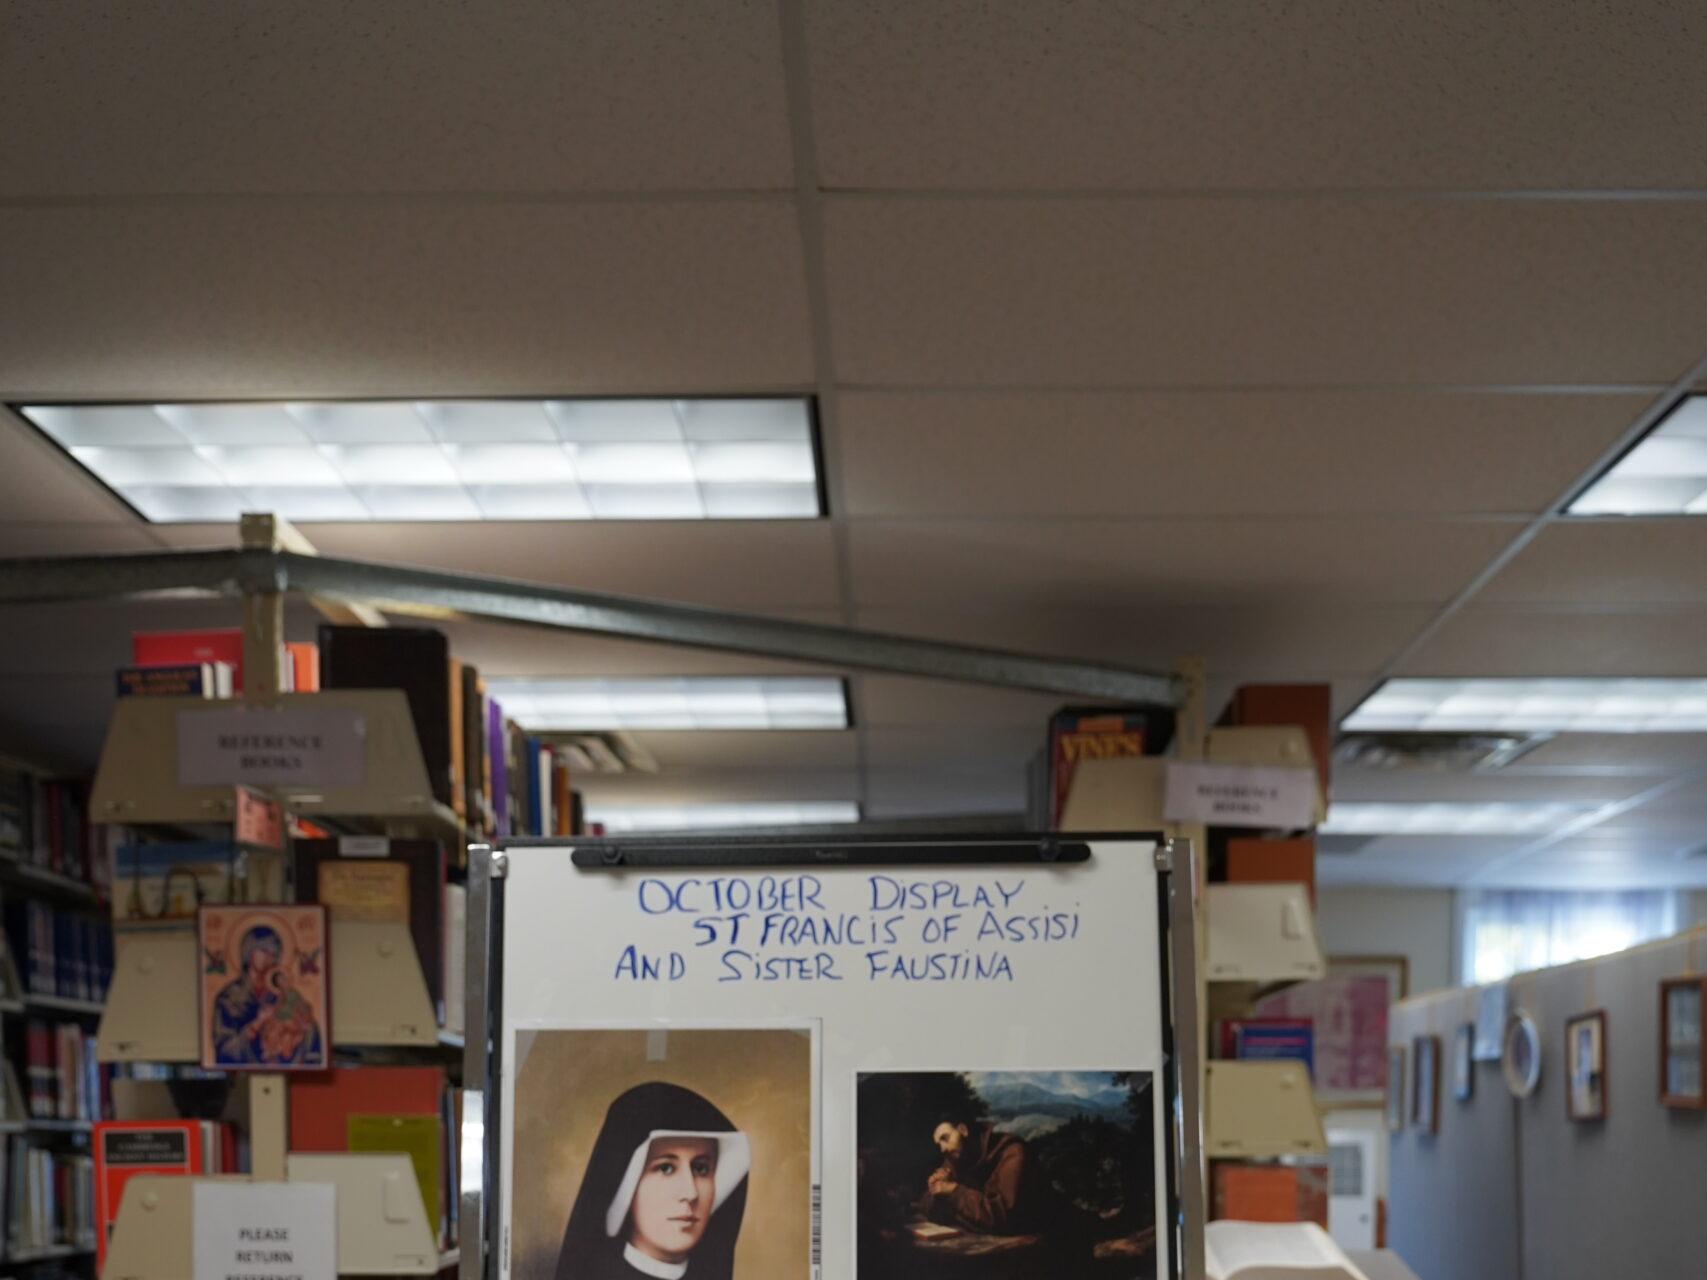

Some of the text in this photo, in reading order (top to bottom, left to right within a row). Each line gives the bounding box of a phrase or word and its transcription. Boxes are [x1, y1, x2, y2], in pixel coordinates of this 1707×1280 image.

[638, 877, 822, 914] OCTOBER
[694, 915, 746, 946] ST
[922, 915, 959, 943] OF
[614, 945, 686, 980] AND
[239, 1228, 289, 1242] PLEASE
[236, 1251, 293, 1264] RETURN
